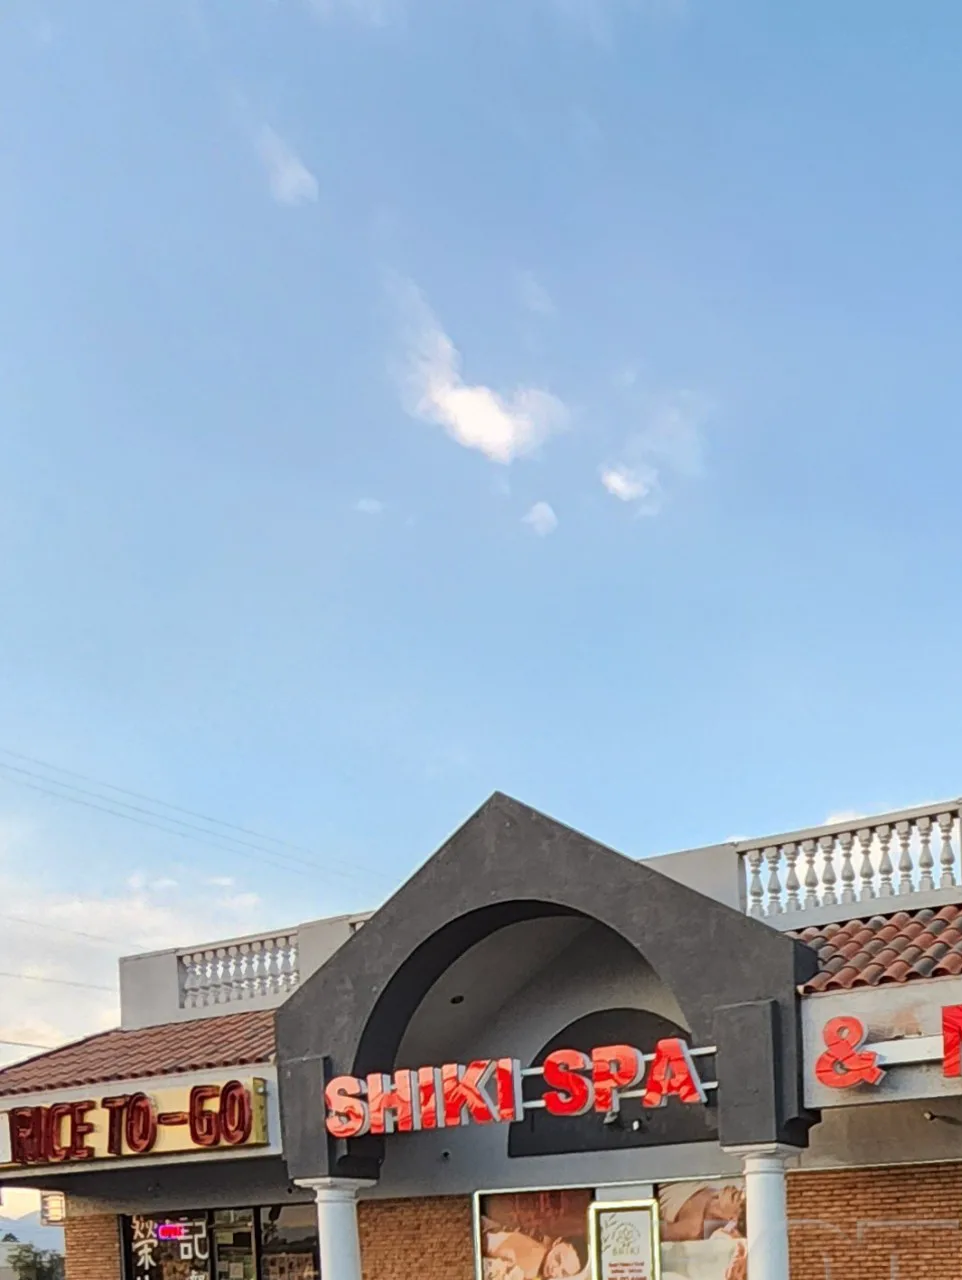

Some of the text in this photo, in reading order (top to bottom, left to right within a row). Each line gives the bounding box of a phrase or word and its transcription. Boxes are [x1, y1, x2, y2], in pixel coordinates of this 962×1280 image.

[324, 1037, 706, 1138] SHIKI SPA
[814, 1015, 885, 1090] &
[9, 1100, 96, 1163] RICE
